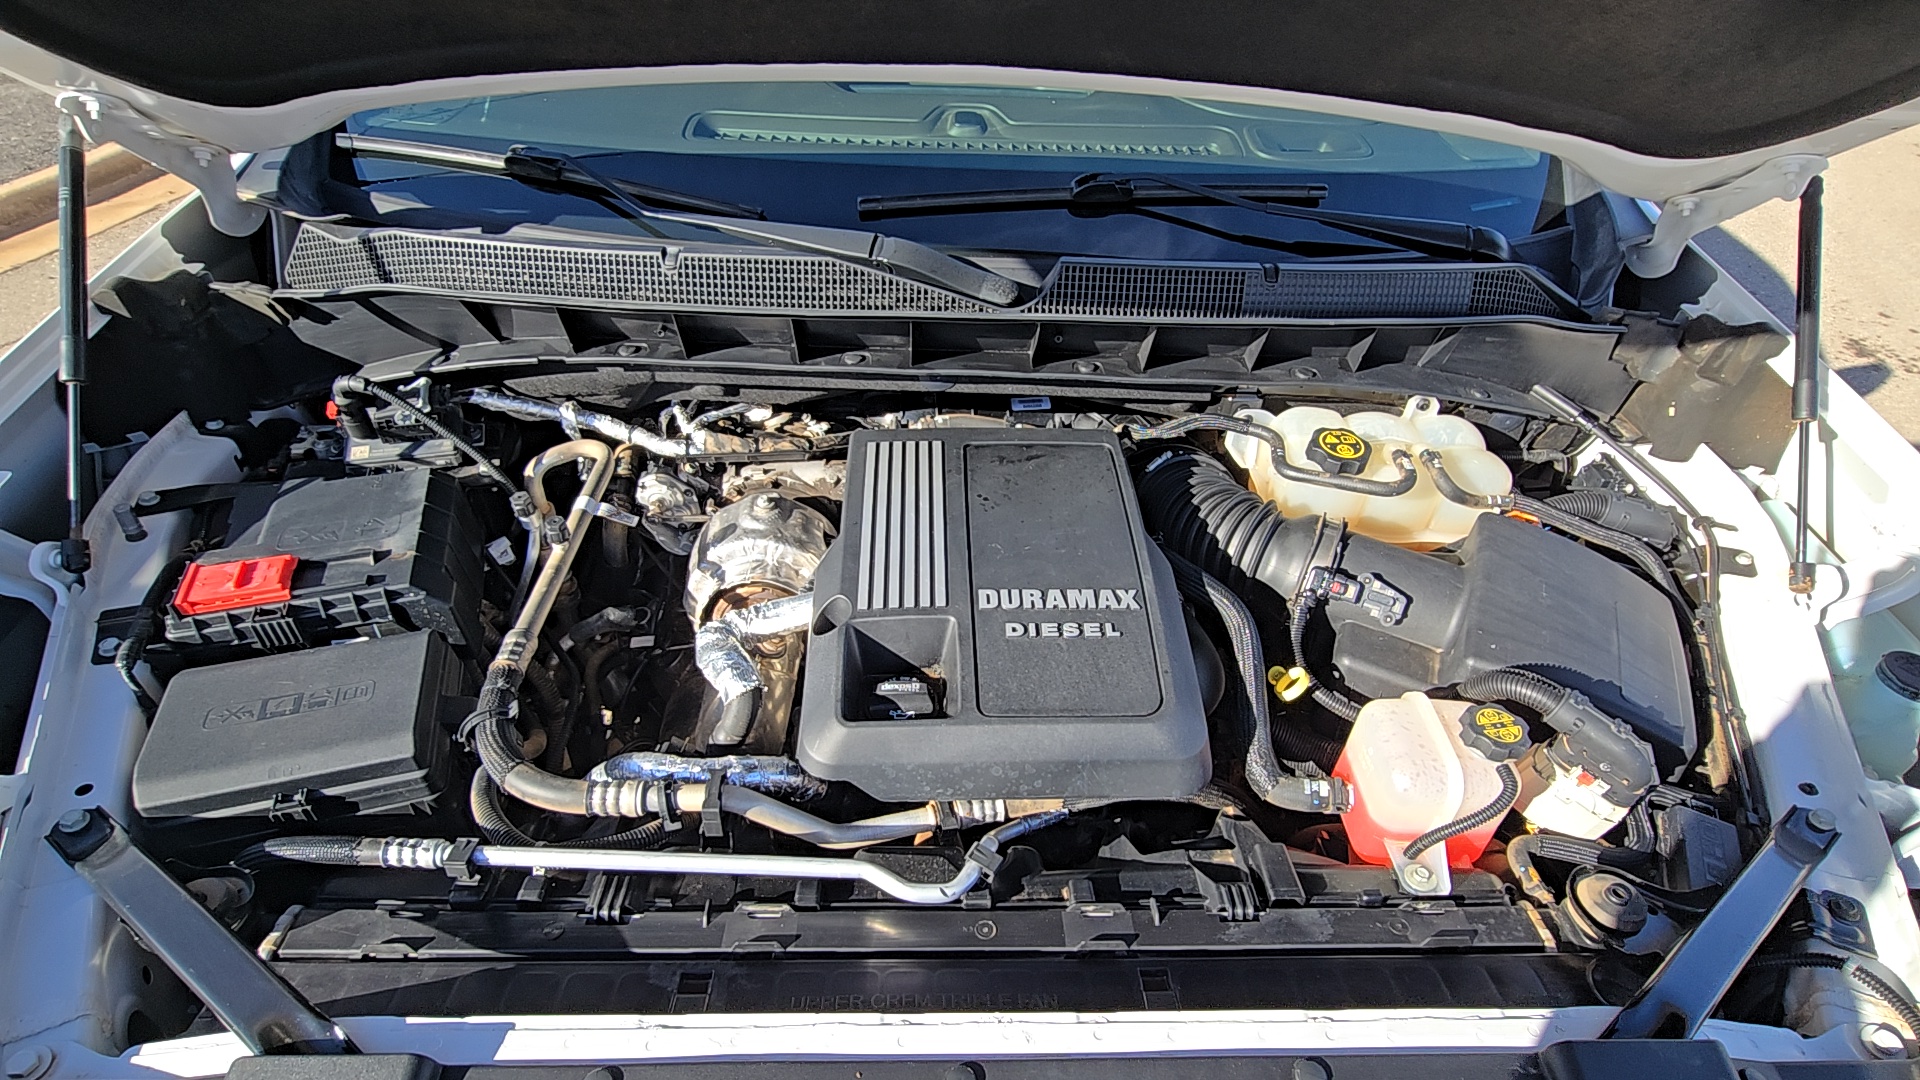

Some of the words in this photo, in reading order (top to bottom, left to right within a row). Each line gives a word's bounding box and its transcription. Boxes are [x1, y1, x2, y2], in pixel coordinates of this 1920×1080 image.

[977, 588, 1142, 610] DURAMAX
[1005, 622, 1122, 638] DIESEL
[790, 994, 864, 1009] UPPER
